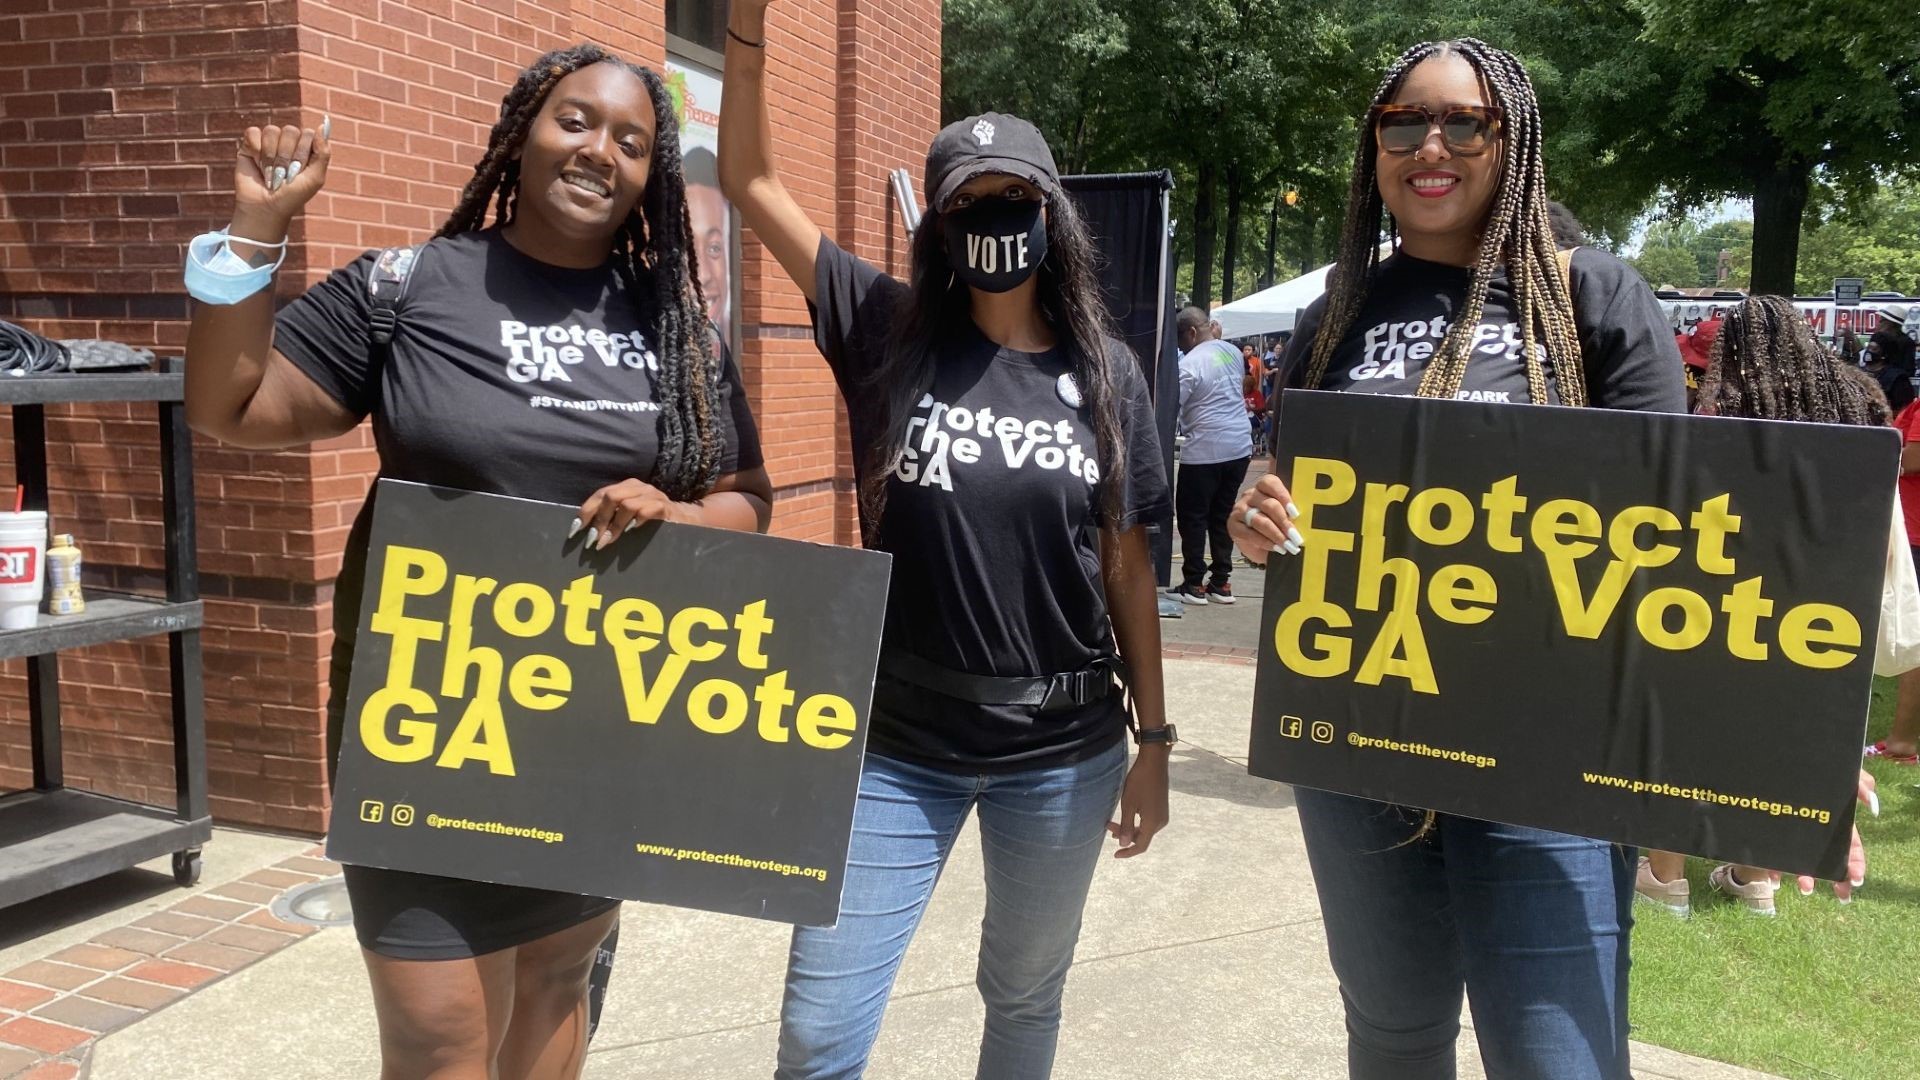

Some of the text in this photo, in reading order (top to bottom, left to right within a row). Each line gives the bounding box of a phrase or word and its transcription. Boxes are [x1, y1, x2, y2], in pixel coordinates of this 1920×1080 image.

[967, 232, 1028, 274] VOTE
[500, 320, 646, 351] Protect
[1364, 315, 1520, 346] Protct
[502, 340, 659, 371] The Vot
[506, 357, 572, 383] GA
[1348, 360, 1406, 381] GA
[1363, 341, 1434, 361] The
[530, 396, 662, 412] #STANDWITHPA
[895, 446, 953, 492] GA
[1000, 438, 1099, 485] Vote
[1291, 456, 1741, 575] Protect
[378, 545, 774, 670] Protect
[1299, 528, 1862, 669] The Vote
[1274, 601, 1440, 695] GA
[370, 613, 857, 750] The Vote
[359, 687, 516, 777] GA
[1347, 732, 1497, 768] @protectthevotega
[1583, 772, 1831, 824] www.protectthevotega.org
[426, 813, 564, 842] @protectthevotega
[636, 842, 827, 881] www.protectthevotega.org
